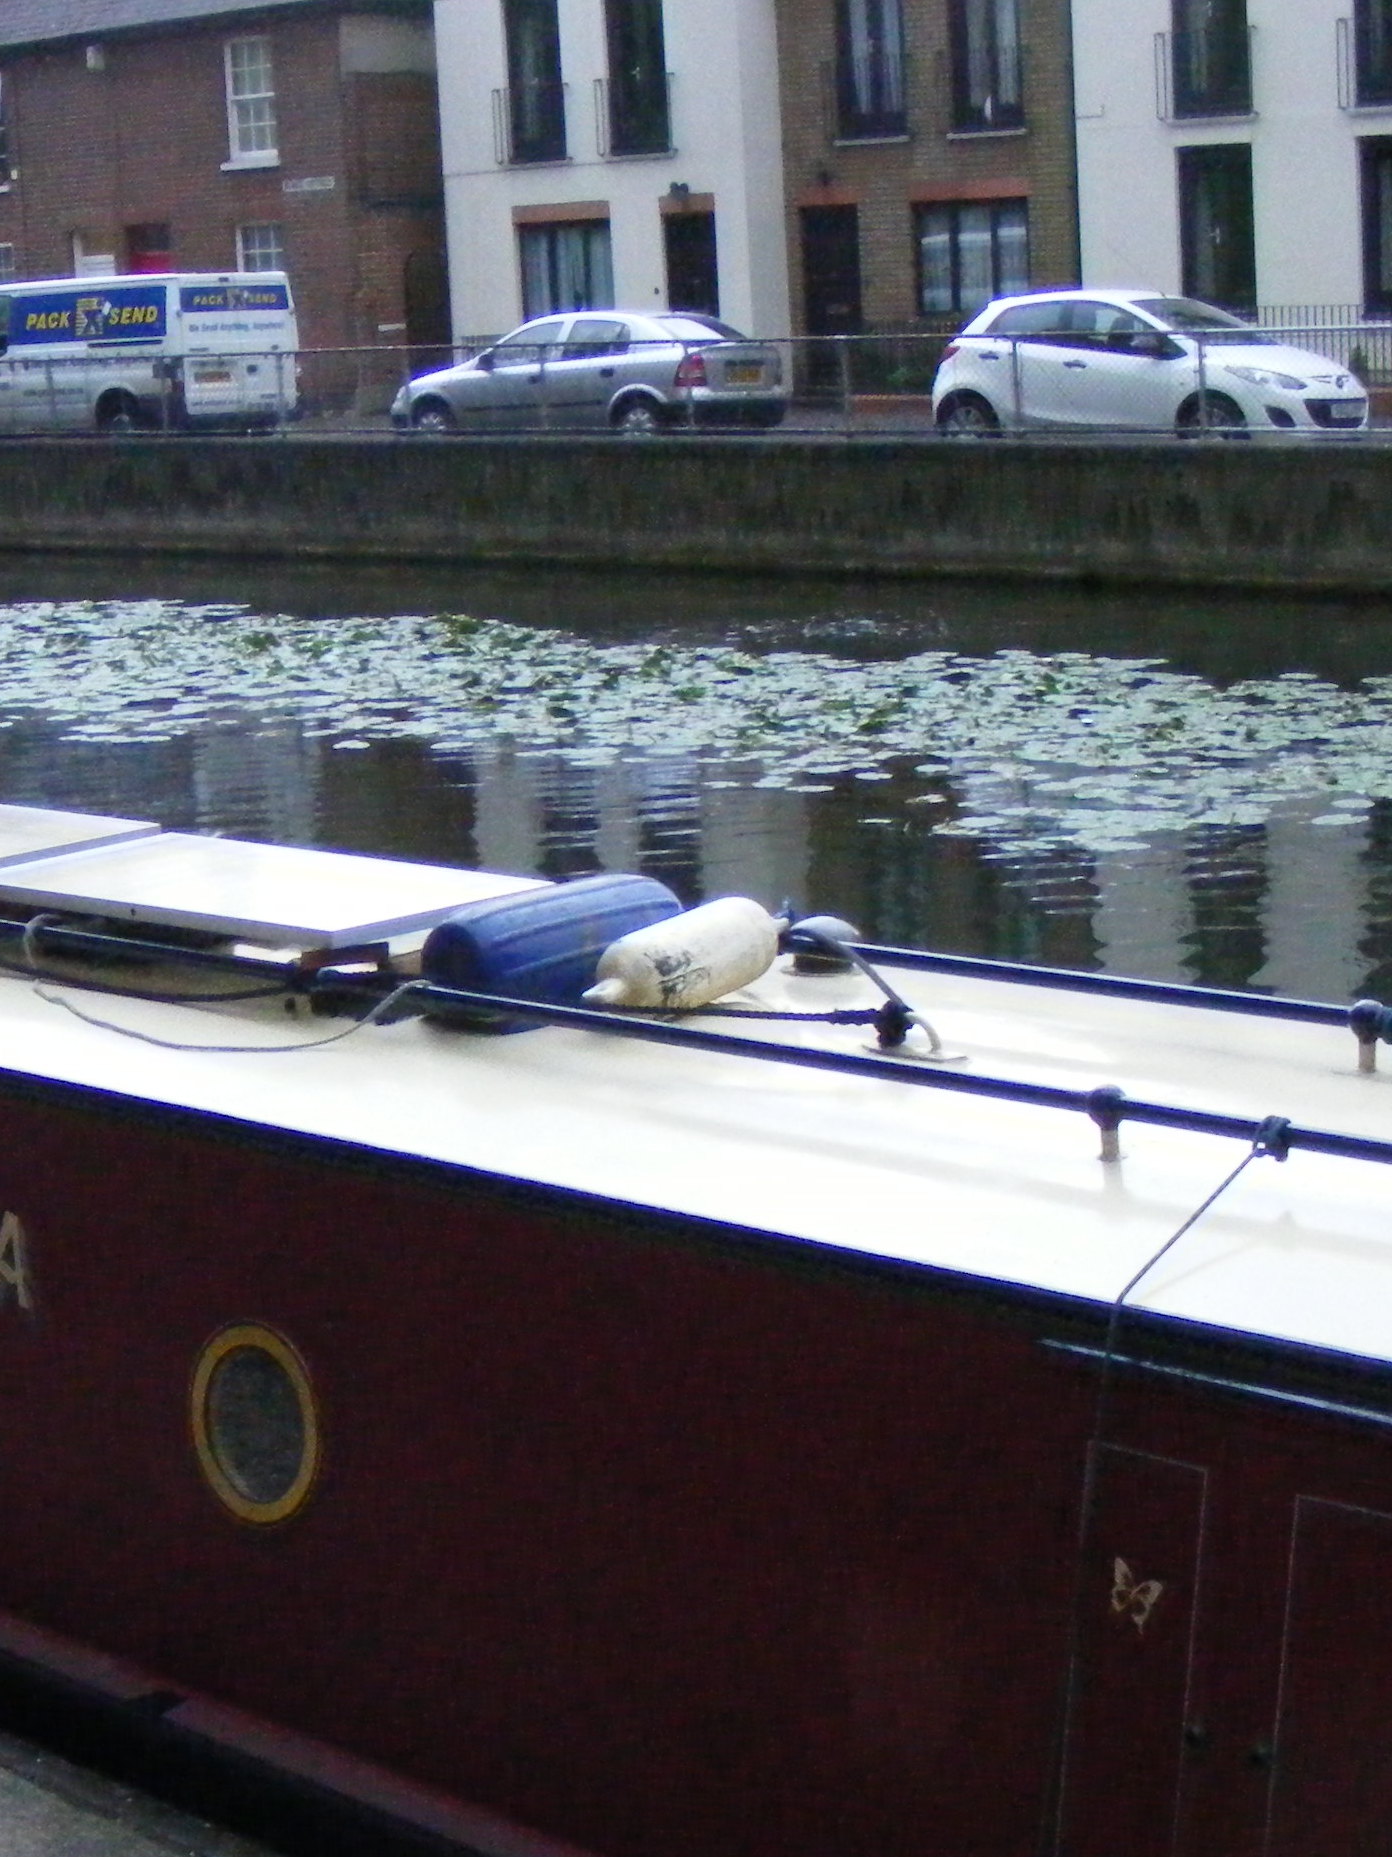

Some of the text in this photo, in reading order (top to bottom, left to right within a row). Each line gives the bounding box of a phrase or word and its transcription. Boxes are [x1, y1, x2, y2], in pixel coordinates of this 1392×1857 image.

[193, 294, 224, 306] PACK
[26, 306, 158, 330] PACK SEND
